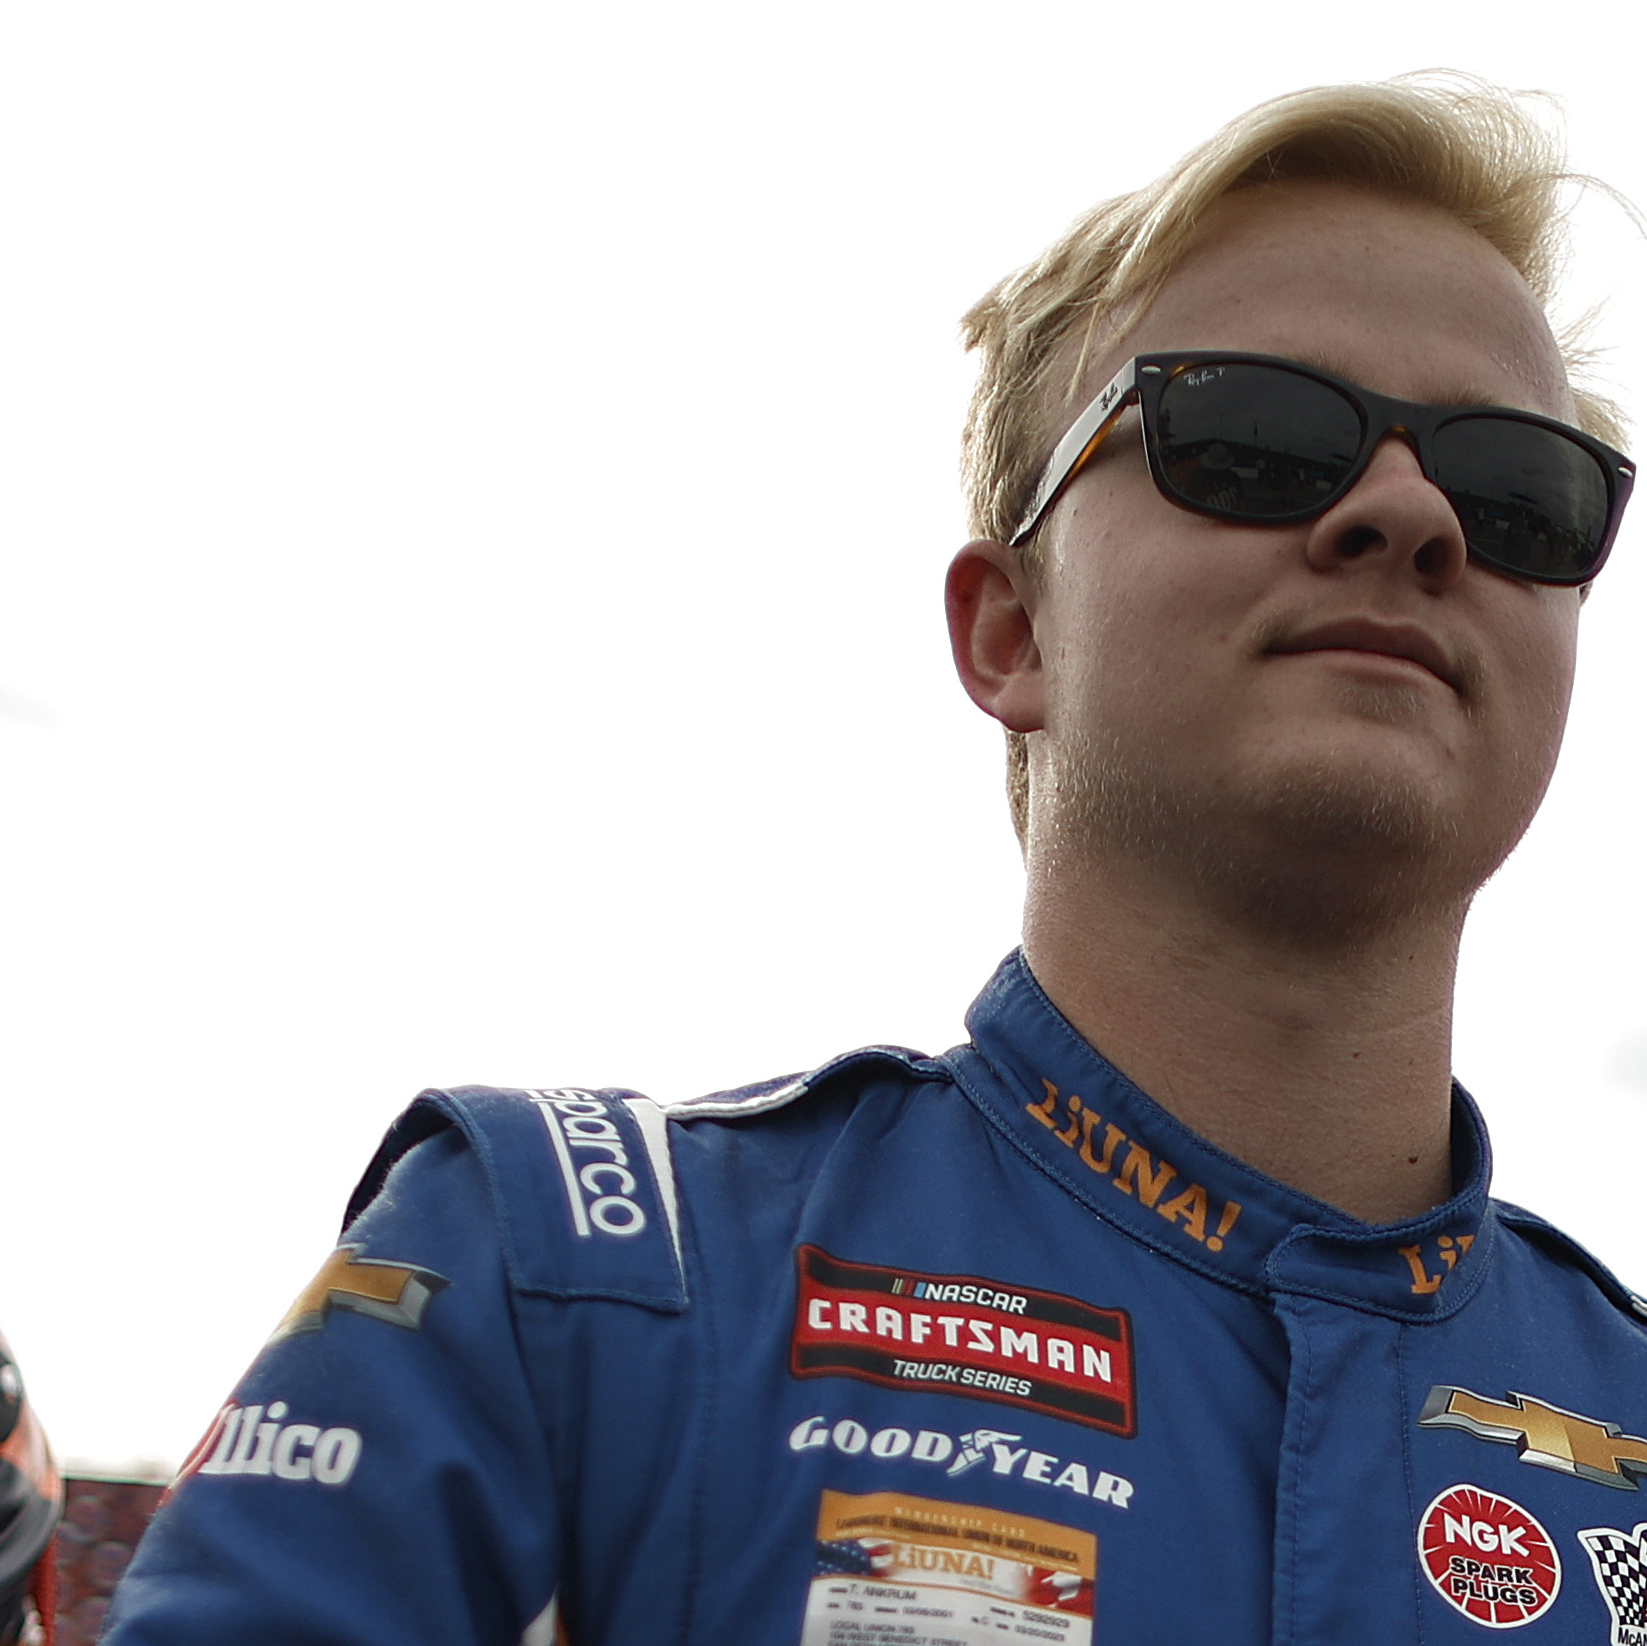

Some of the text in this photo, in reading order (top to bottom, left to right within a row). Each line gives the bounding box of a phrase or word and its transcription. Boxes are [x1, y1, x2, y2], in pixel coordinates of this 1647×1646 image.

[924, 1282, 1027, 1315] NASCAR
[808, 1298, 1112, 1383] CRAFTSMAN
[893, 1359, 1032, 1397] TRUCK SERIES
[197, 1400, 363, 1484] llico
[1443, 1513, 1530, 1557] NGK
[890, 1545, 994, 1580] LiUNA!
[1448, 1557, 1535, 1586] SPARK
[863, 1586, 917, 1600] ANKRUM
[1452, 1577, 1538, 1608] PLUGS
